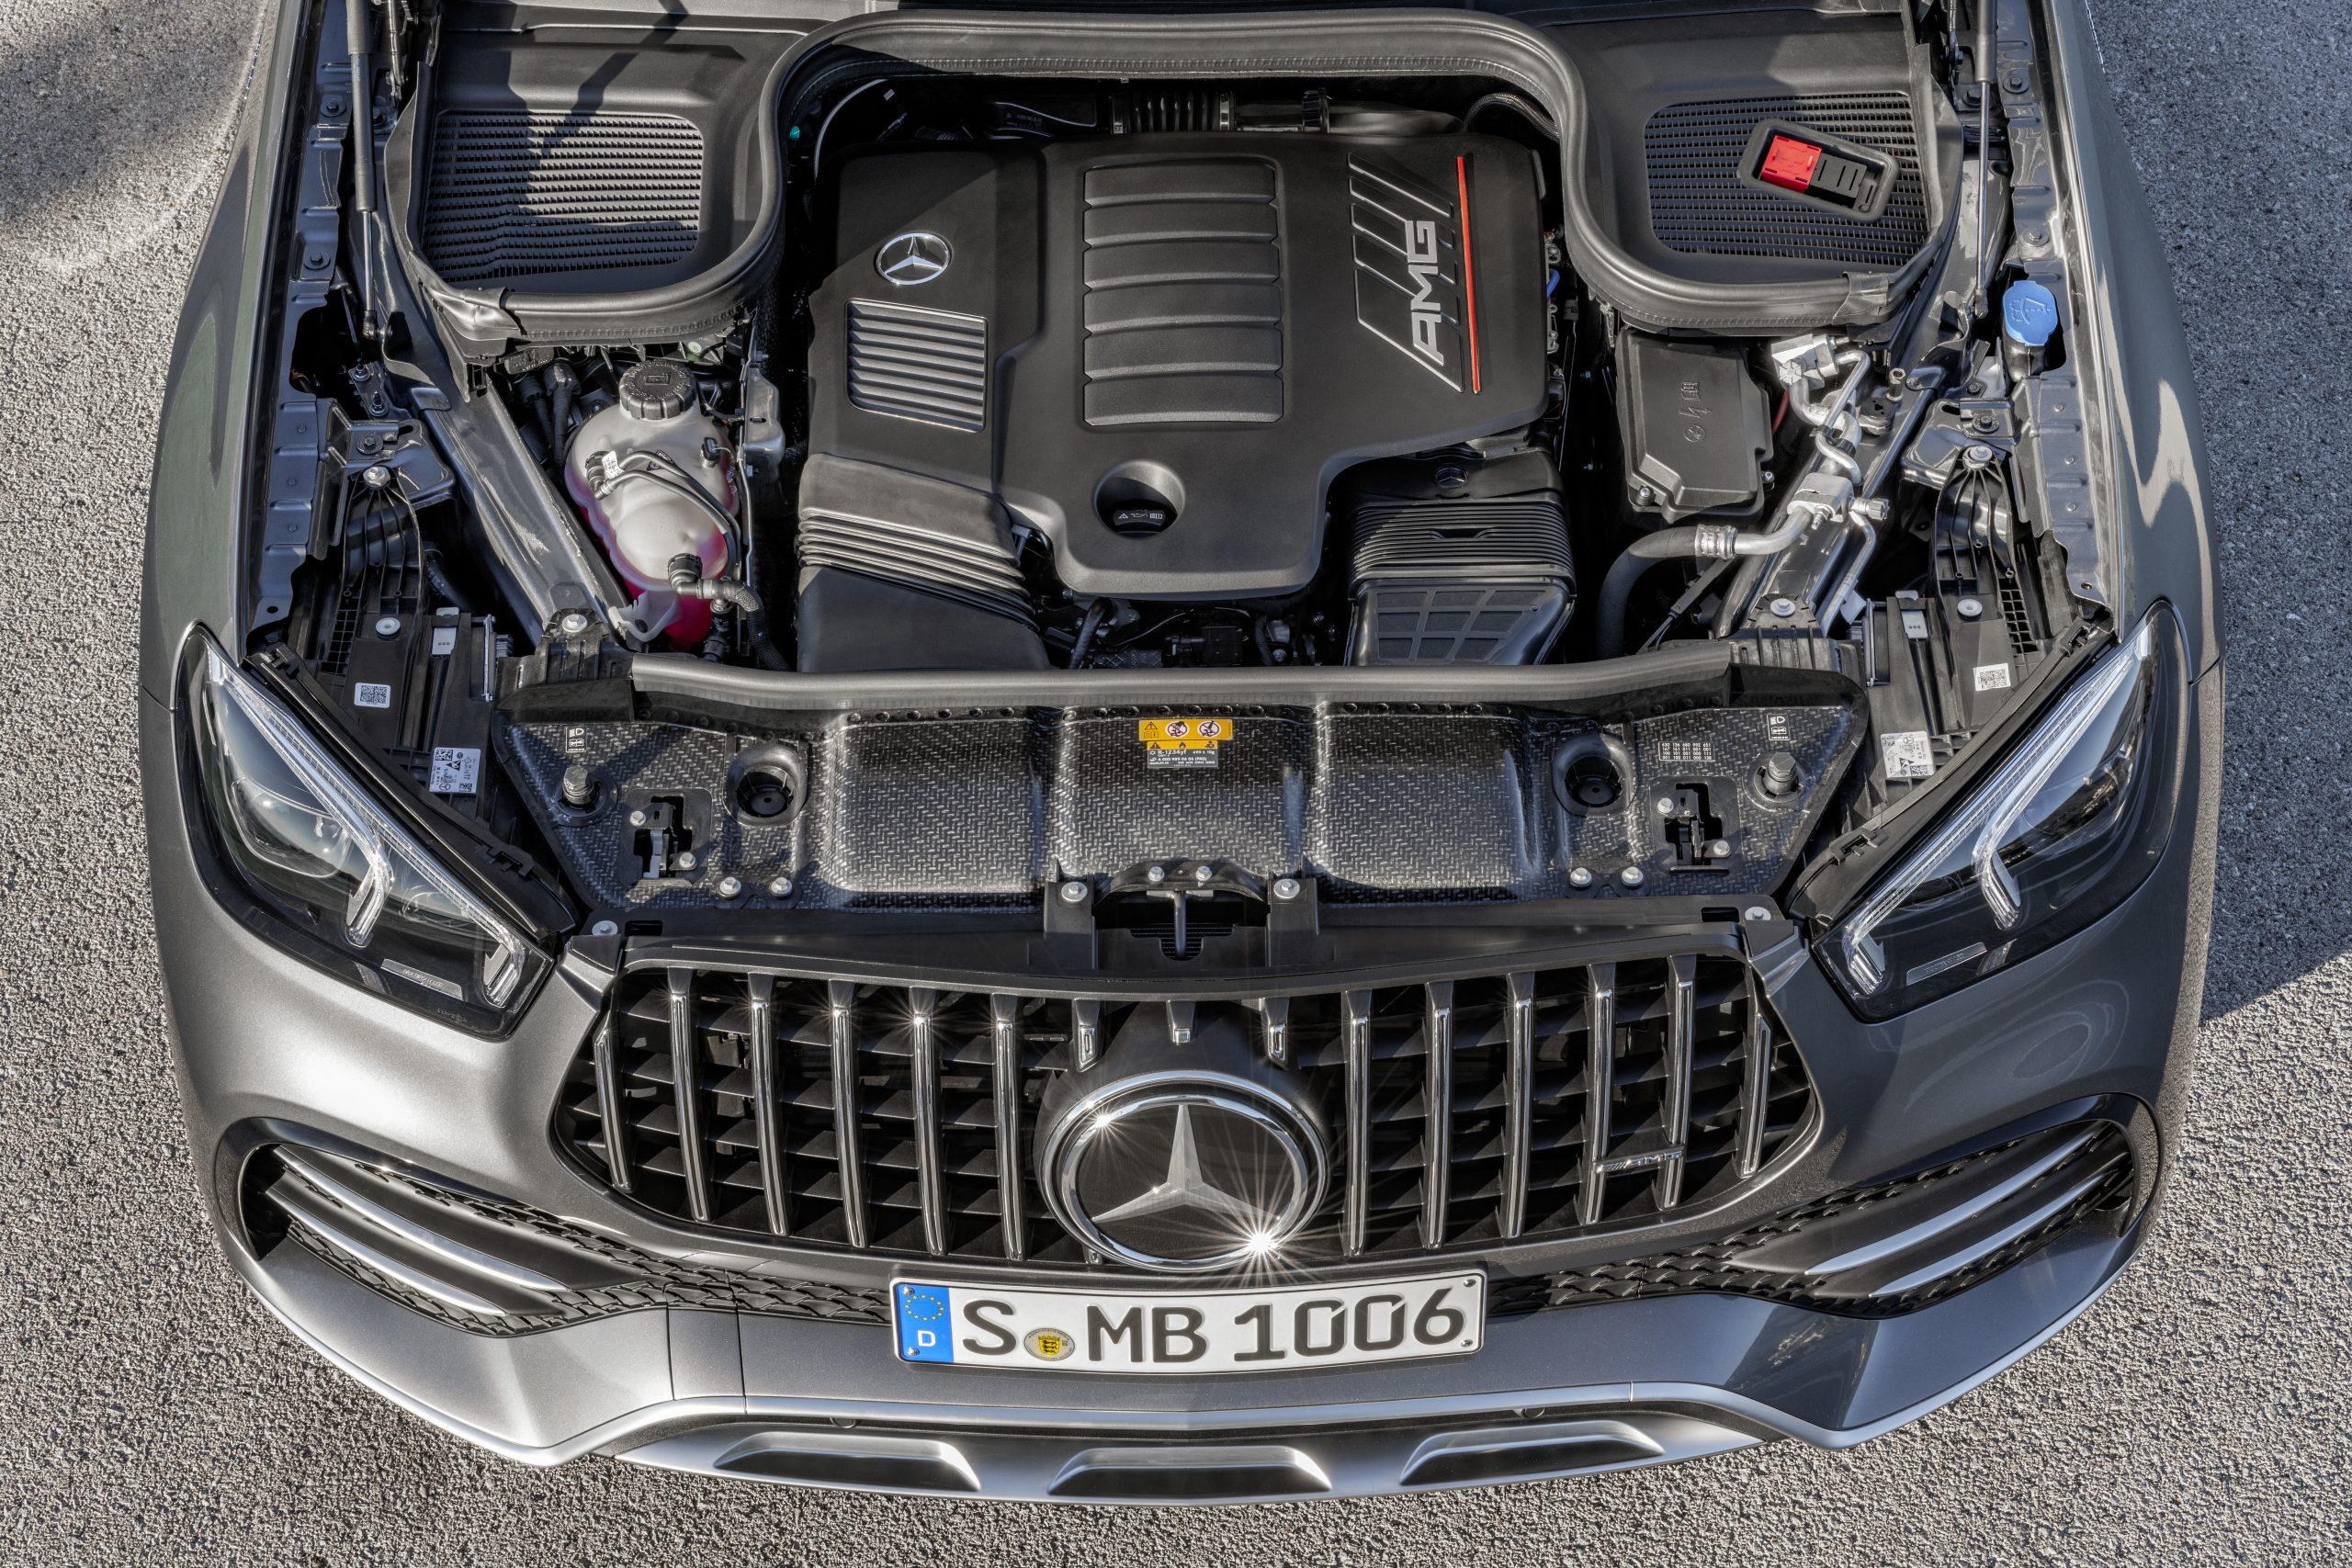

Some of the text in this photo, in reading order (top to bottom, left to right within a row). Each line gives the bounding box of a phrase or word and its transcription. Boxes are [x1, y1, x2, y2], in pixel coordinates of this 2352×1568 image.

[1405, 220, 1444, 366] AMG
[1627, 1150, 1682, 1166] AMG
[918, 1330, 936, 1347] D
[962, 1299, 1017, 1355] S
[1087, 1305, 1208, 1363] MB
[1234, 1288, 1465, 1362] 1006
